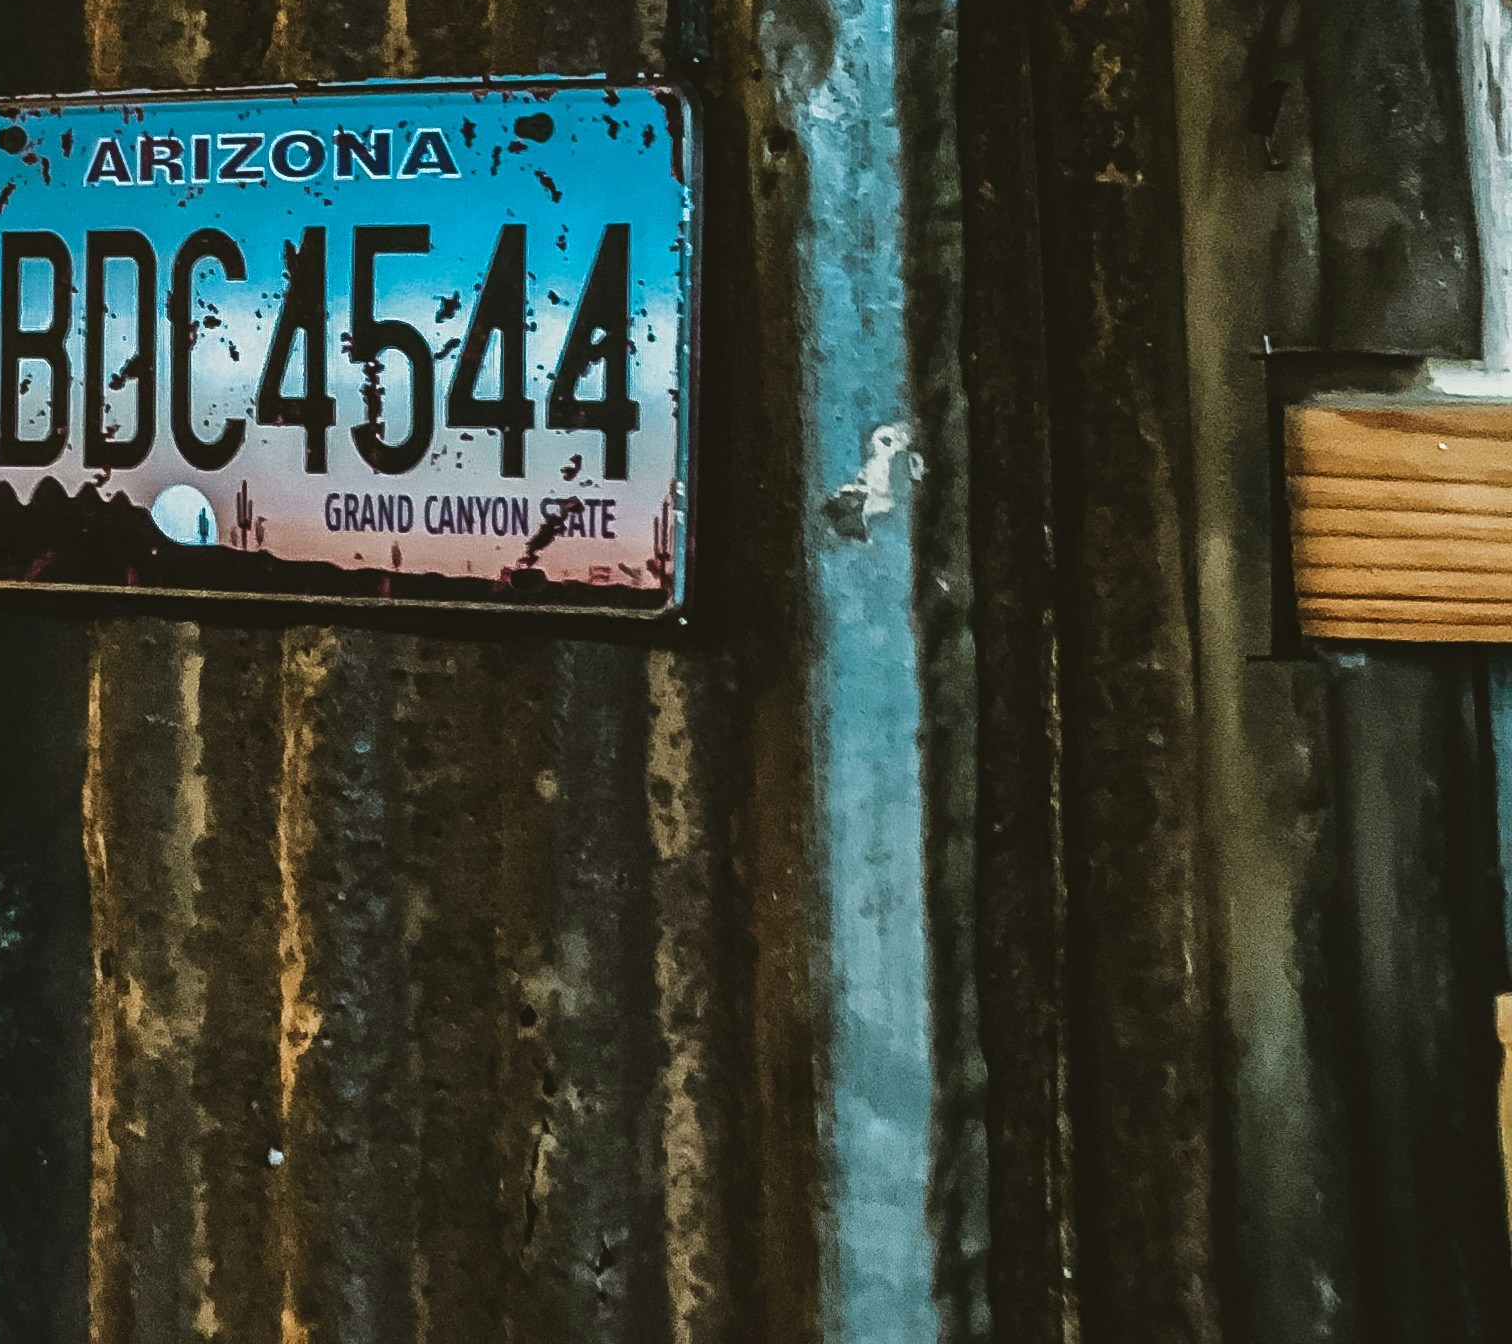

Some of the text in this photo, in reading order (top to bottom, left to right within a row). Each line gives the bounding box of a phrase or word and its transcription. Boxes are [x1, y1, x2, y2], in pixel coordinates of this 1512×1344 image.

[85, 126, 462, 187] ARIZONA
[324, 491, 415, 534] GRAND
[424, 494, 530, 537] CANYON
